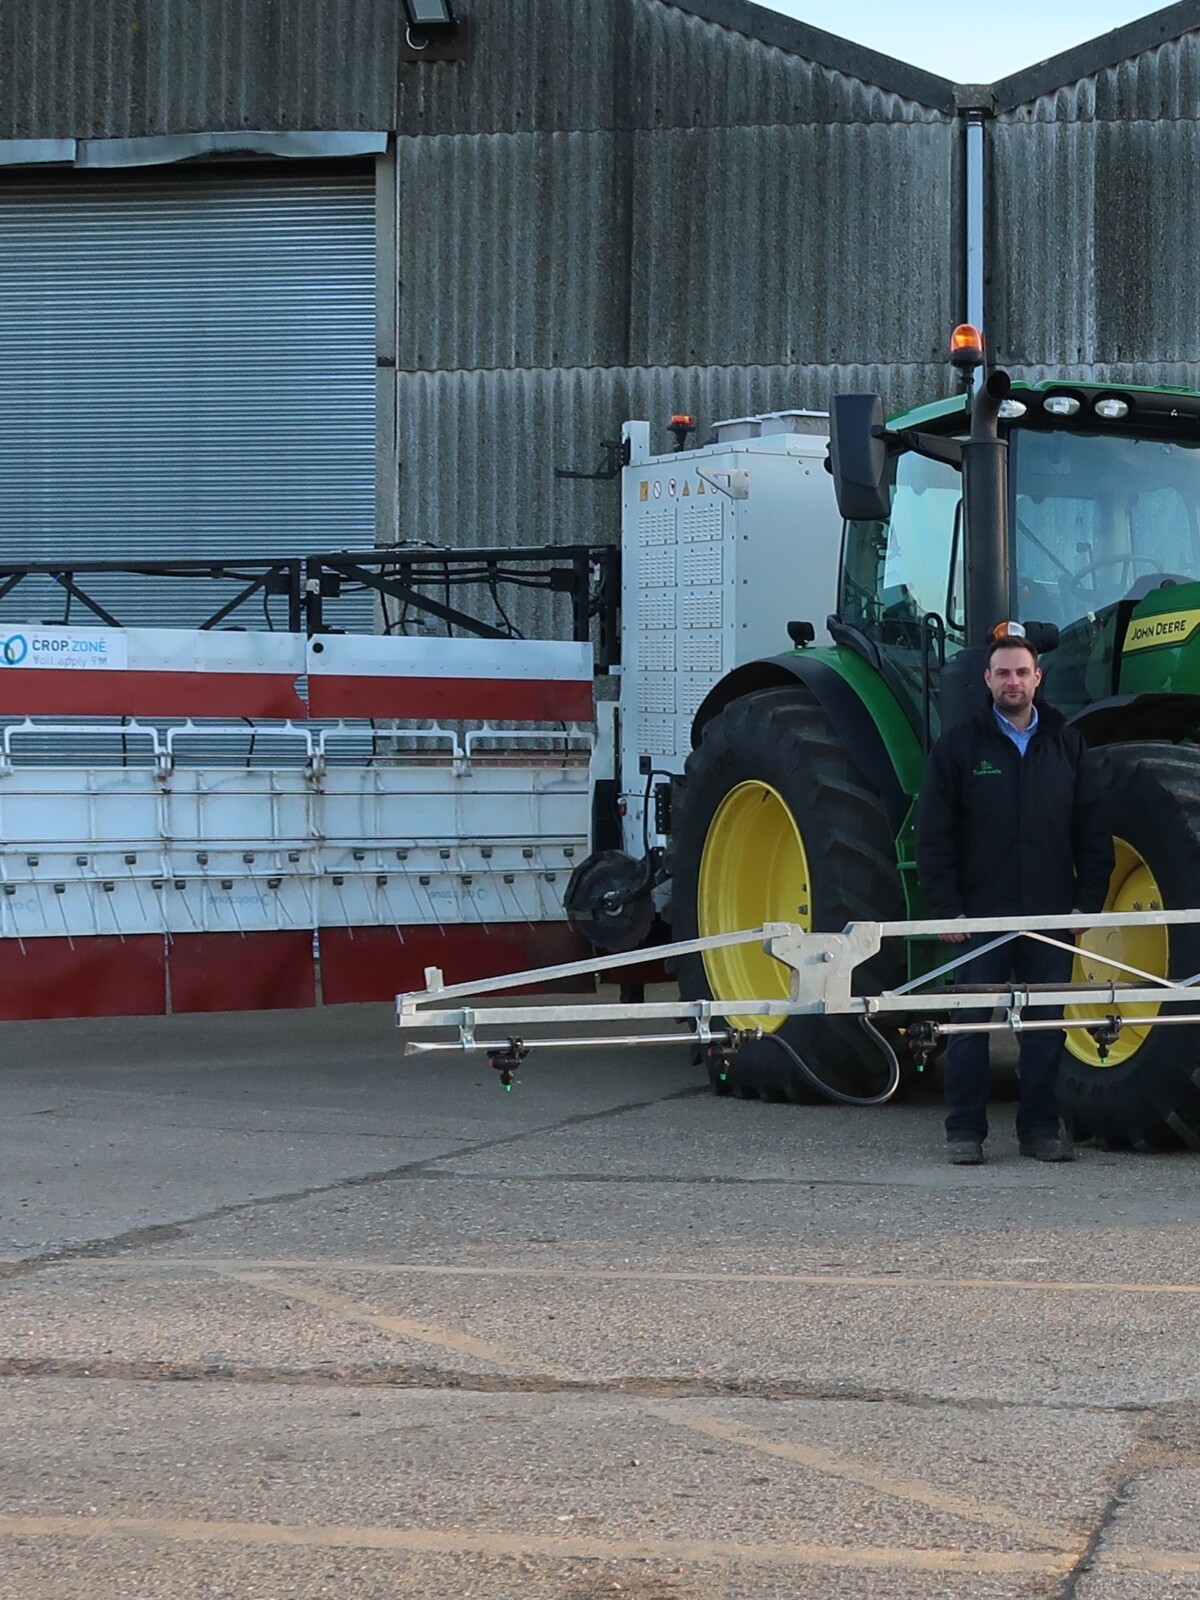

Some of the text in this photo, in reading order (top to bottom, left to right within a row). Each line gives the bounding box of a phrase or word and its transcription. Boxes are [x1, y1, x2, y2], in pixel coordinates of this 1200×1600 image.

[1131, 619, 1187, 641] JOHN DEERE
[32, 639, 106, 653] CROP.ZONE
